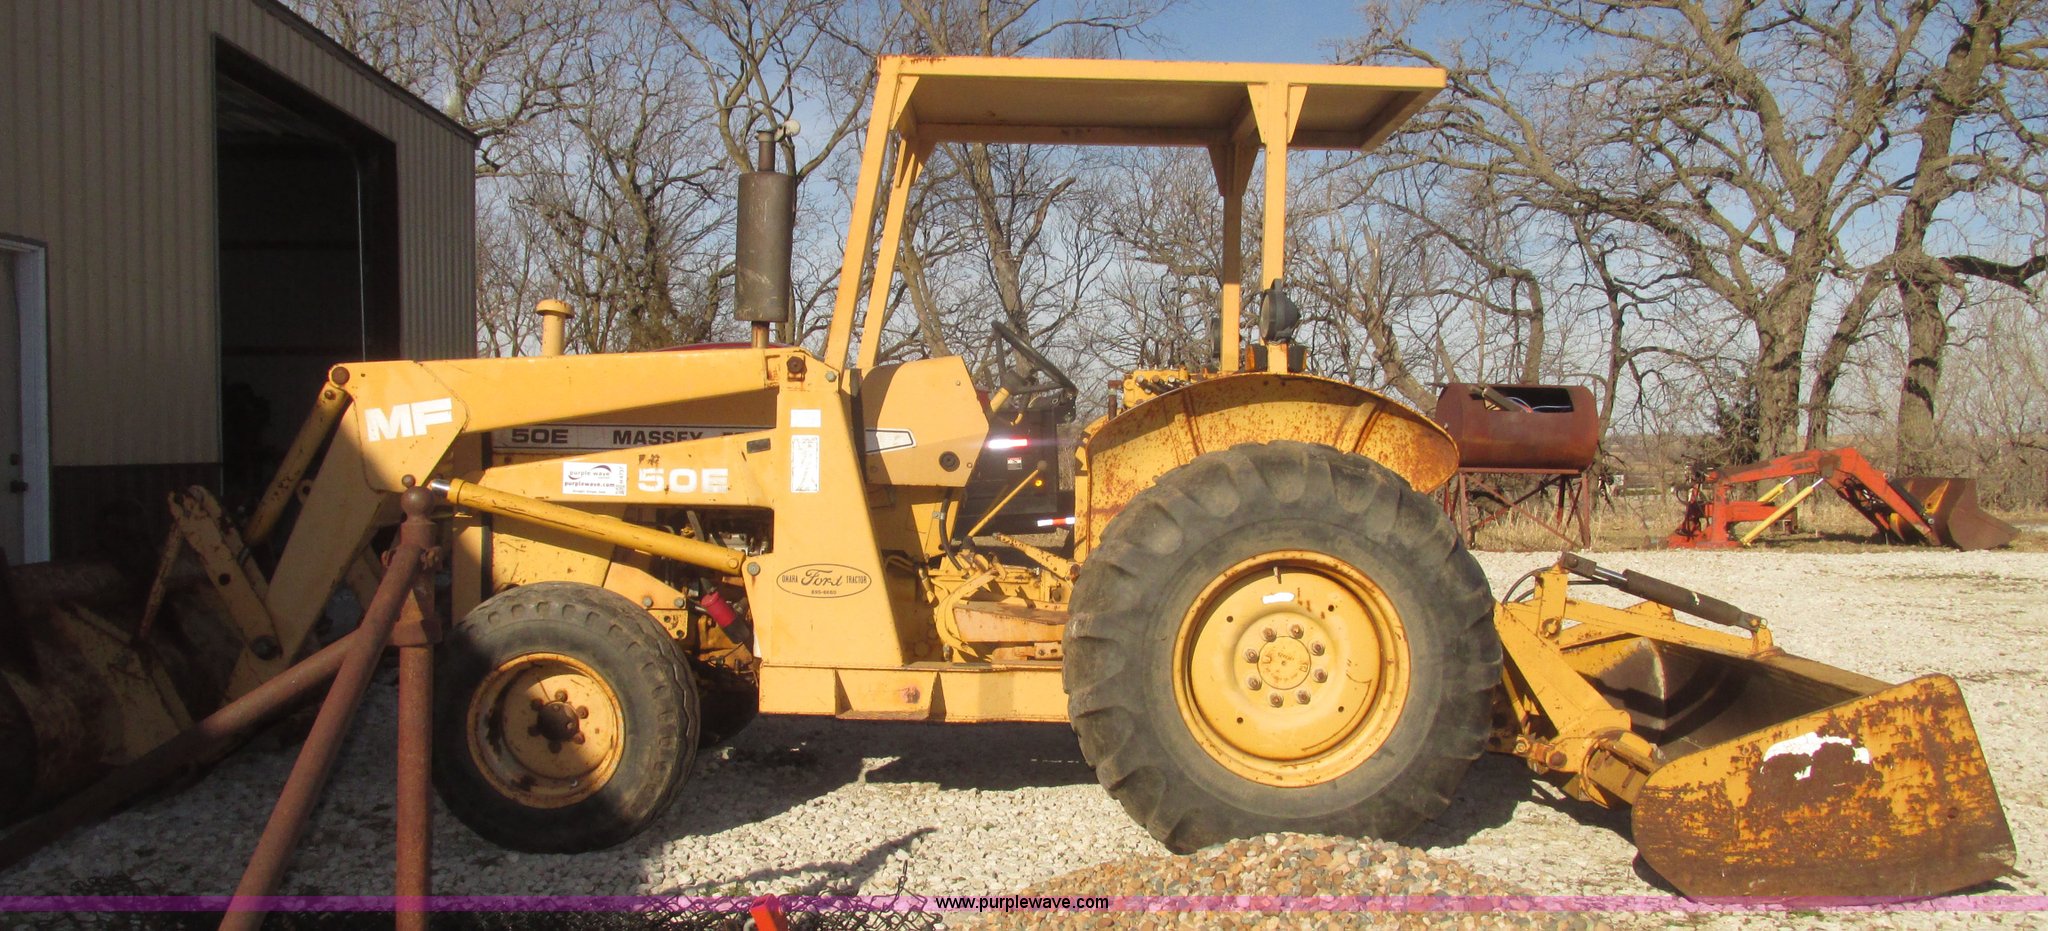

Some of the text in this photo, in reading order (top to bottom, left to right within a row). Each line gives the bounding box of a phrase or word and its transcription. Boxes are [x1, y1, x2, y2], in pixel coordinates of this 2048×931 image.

[364, 397, 453, 443] MF
[511, 428, 703, 445] 50E MASSEY
[569, 470, 591, 478] purple
[637, 467, 729, 494] 50E
[564, 480, 615, 488] purplewave.com
[781, 568, 867, 587] OMAHA Ford TRACTOR
